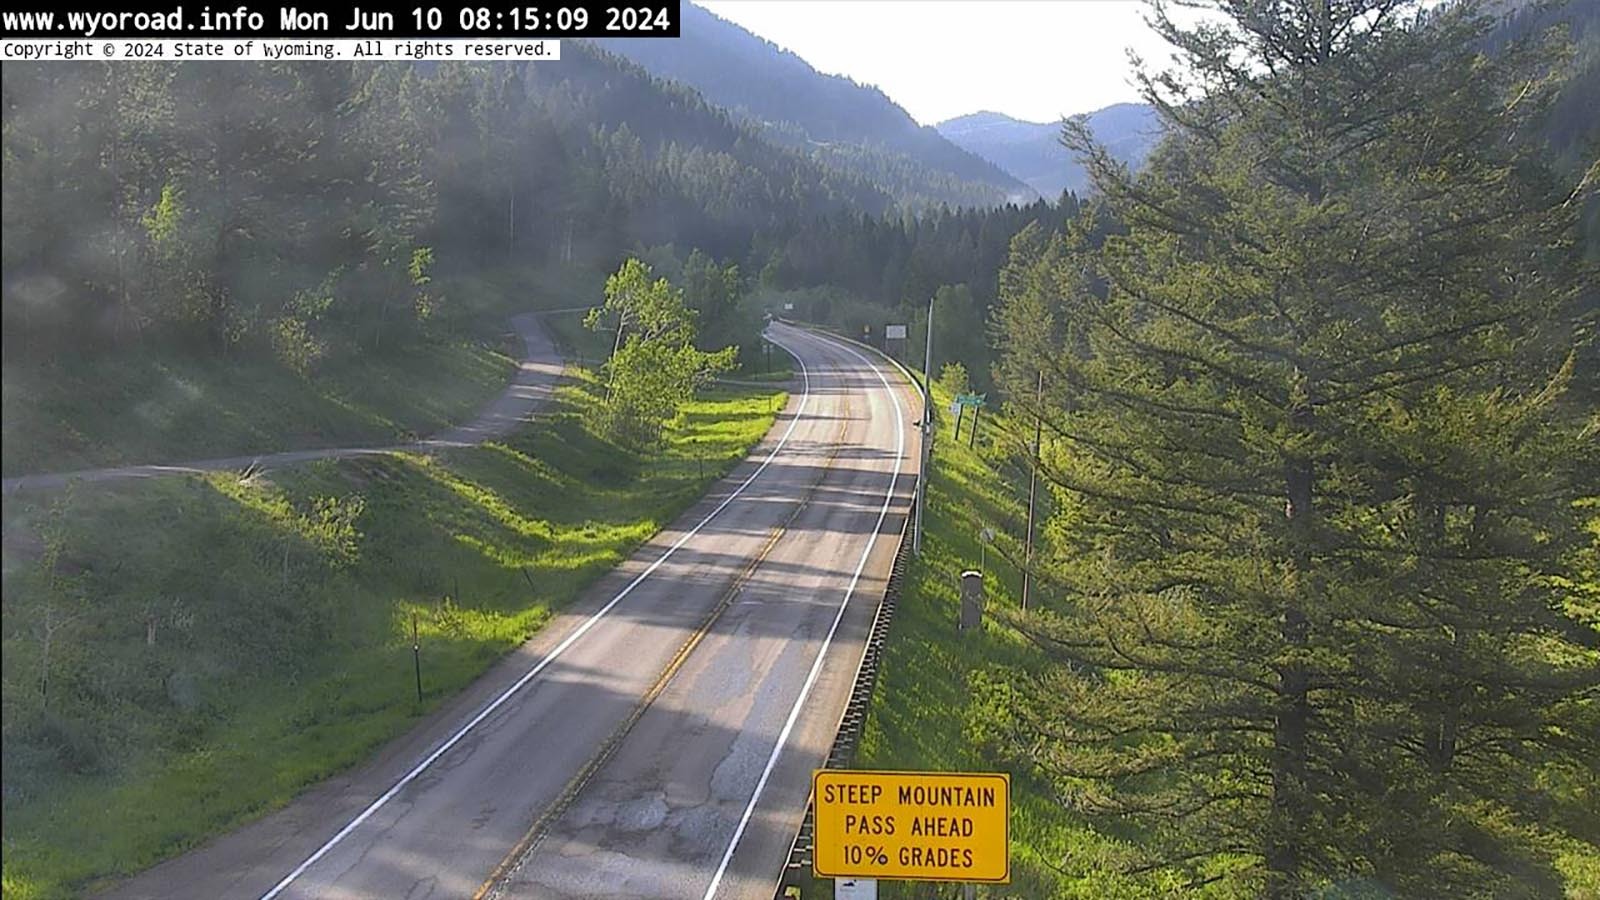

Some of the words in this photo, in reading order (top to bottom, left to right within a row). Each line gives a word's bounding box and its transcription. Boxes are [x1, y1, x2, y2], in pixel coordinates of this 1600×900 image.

[824, 784, 882, 804] STEEP
[898, 785, 995, 807] MOUNTAIN
[845, 815, 895, 835] PASS
[911, 817, 973, 837] AHEAD
[844, 845, 889, 866] 10%
[899, 846, 973, 868] GRADES
